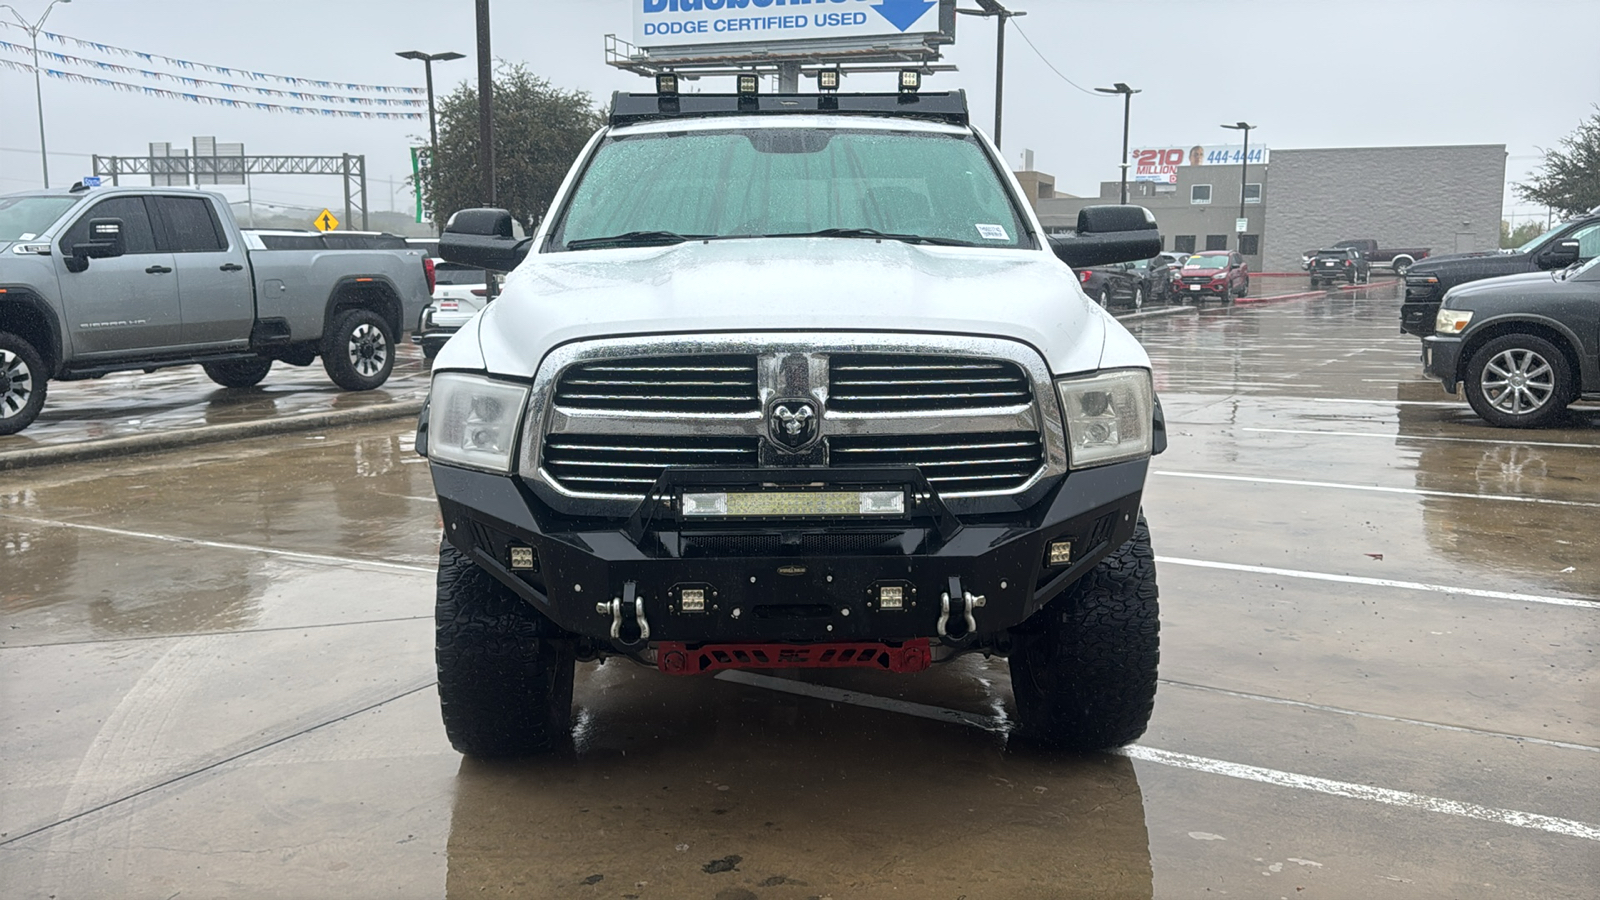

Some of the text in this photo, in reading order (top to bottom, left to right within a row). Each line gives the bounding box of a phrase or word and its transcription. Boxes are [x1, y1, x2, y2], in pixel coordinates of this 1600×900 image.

[644, 12, 867, 35] DODGE CERTIFIED USED
[1132, 149, 1184, 166] $210
[1136, 165, 1177, 175] MILLION
